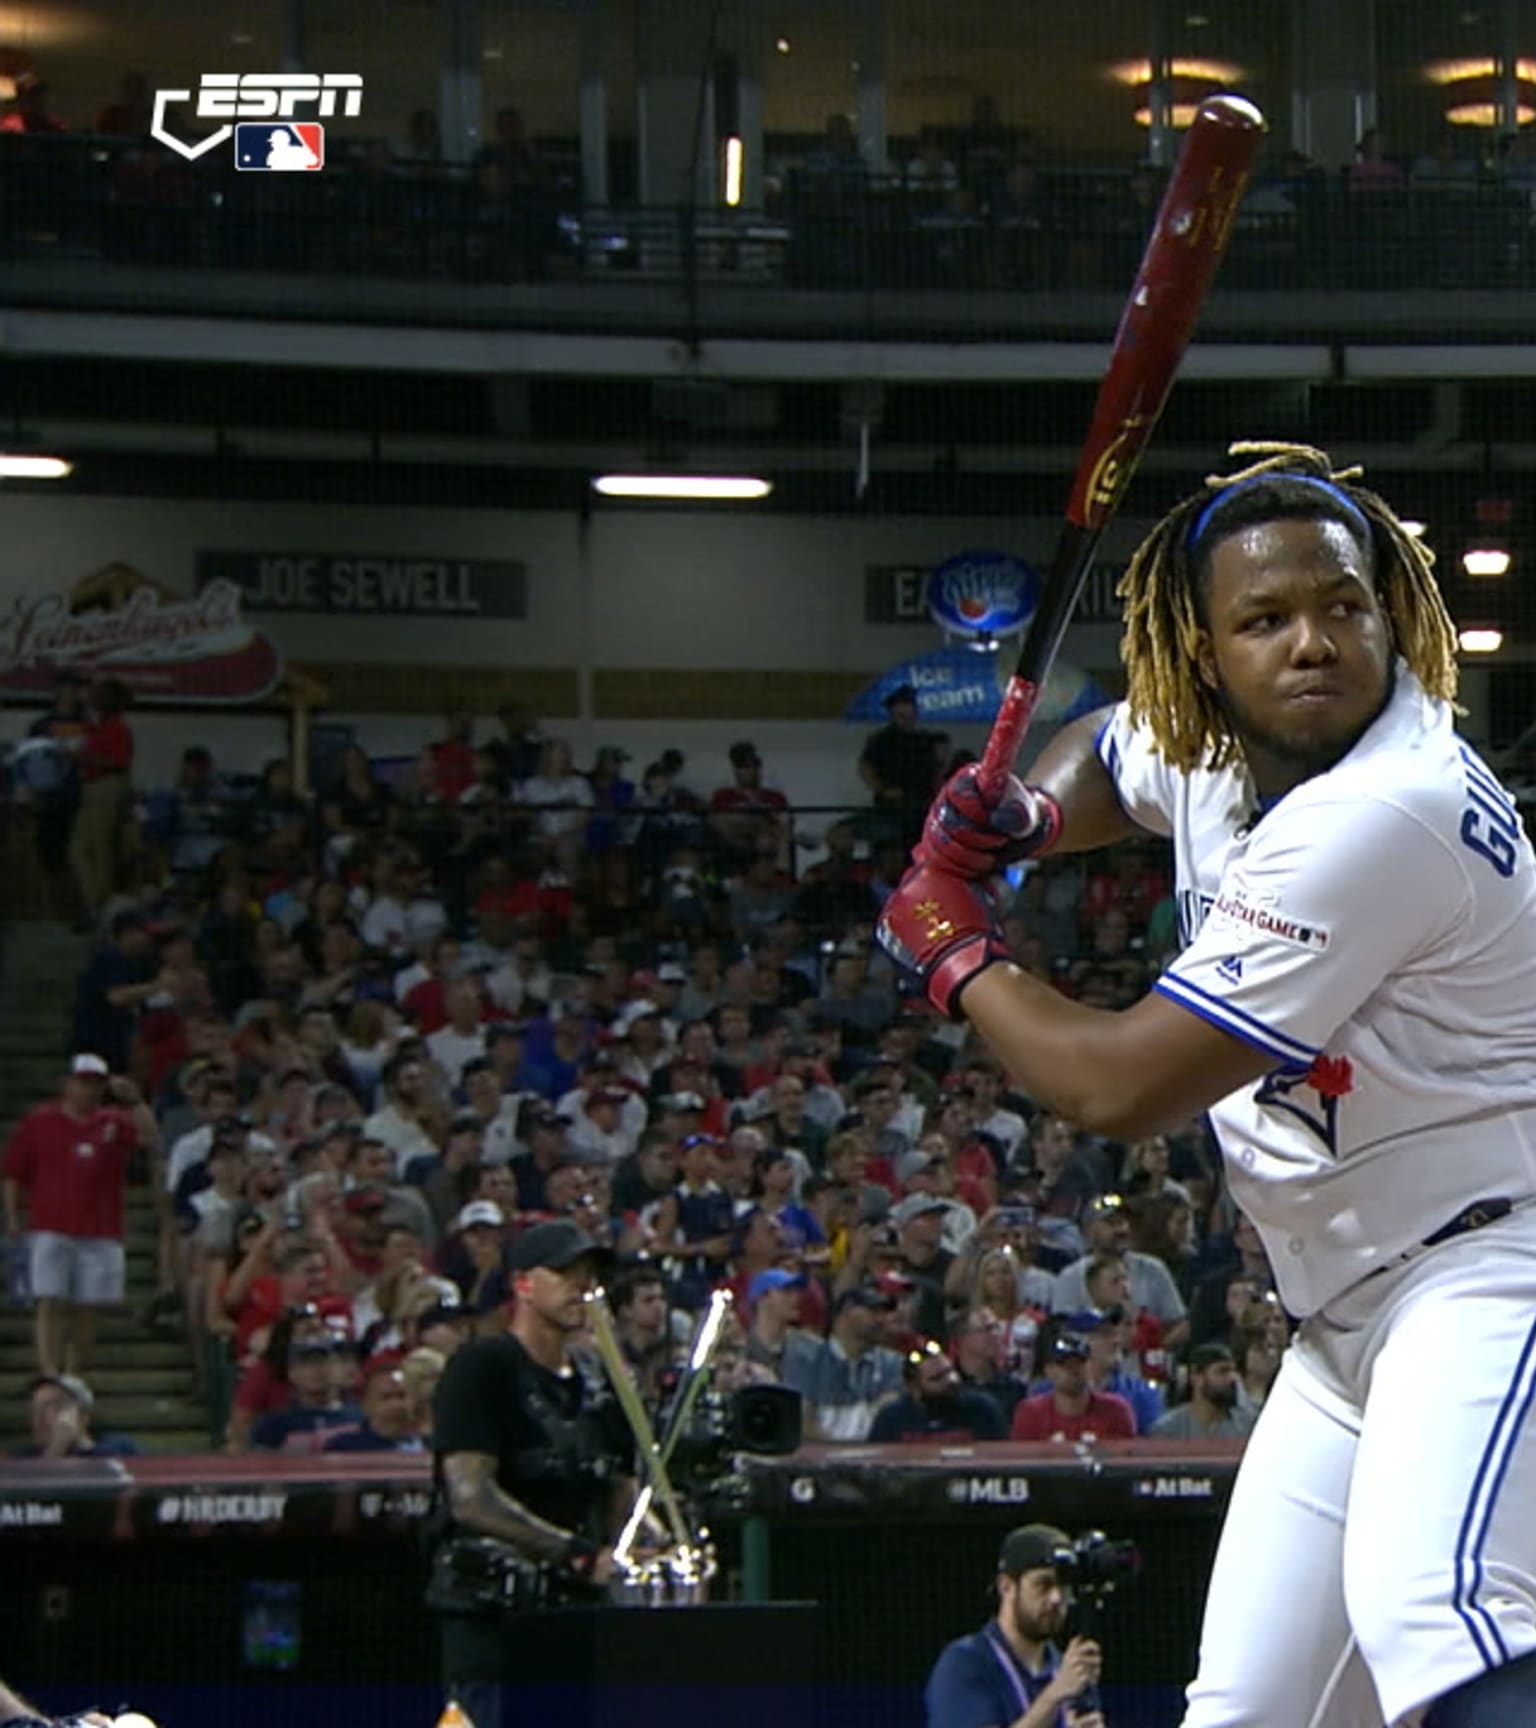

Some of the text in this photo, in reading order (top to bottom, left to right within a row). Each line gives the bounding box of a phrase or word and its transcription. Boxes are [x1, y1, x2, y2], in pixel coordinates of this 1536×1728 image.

[246, 557, 480, 612] JOE SEWELL
[909, 665, 953, 689] Ice
[1257, 909, 1299, 939] GAME
[1153, 1478, 1212, 1498] At Bat
[156, 1494, 288, 1524] #HRDERBY
